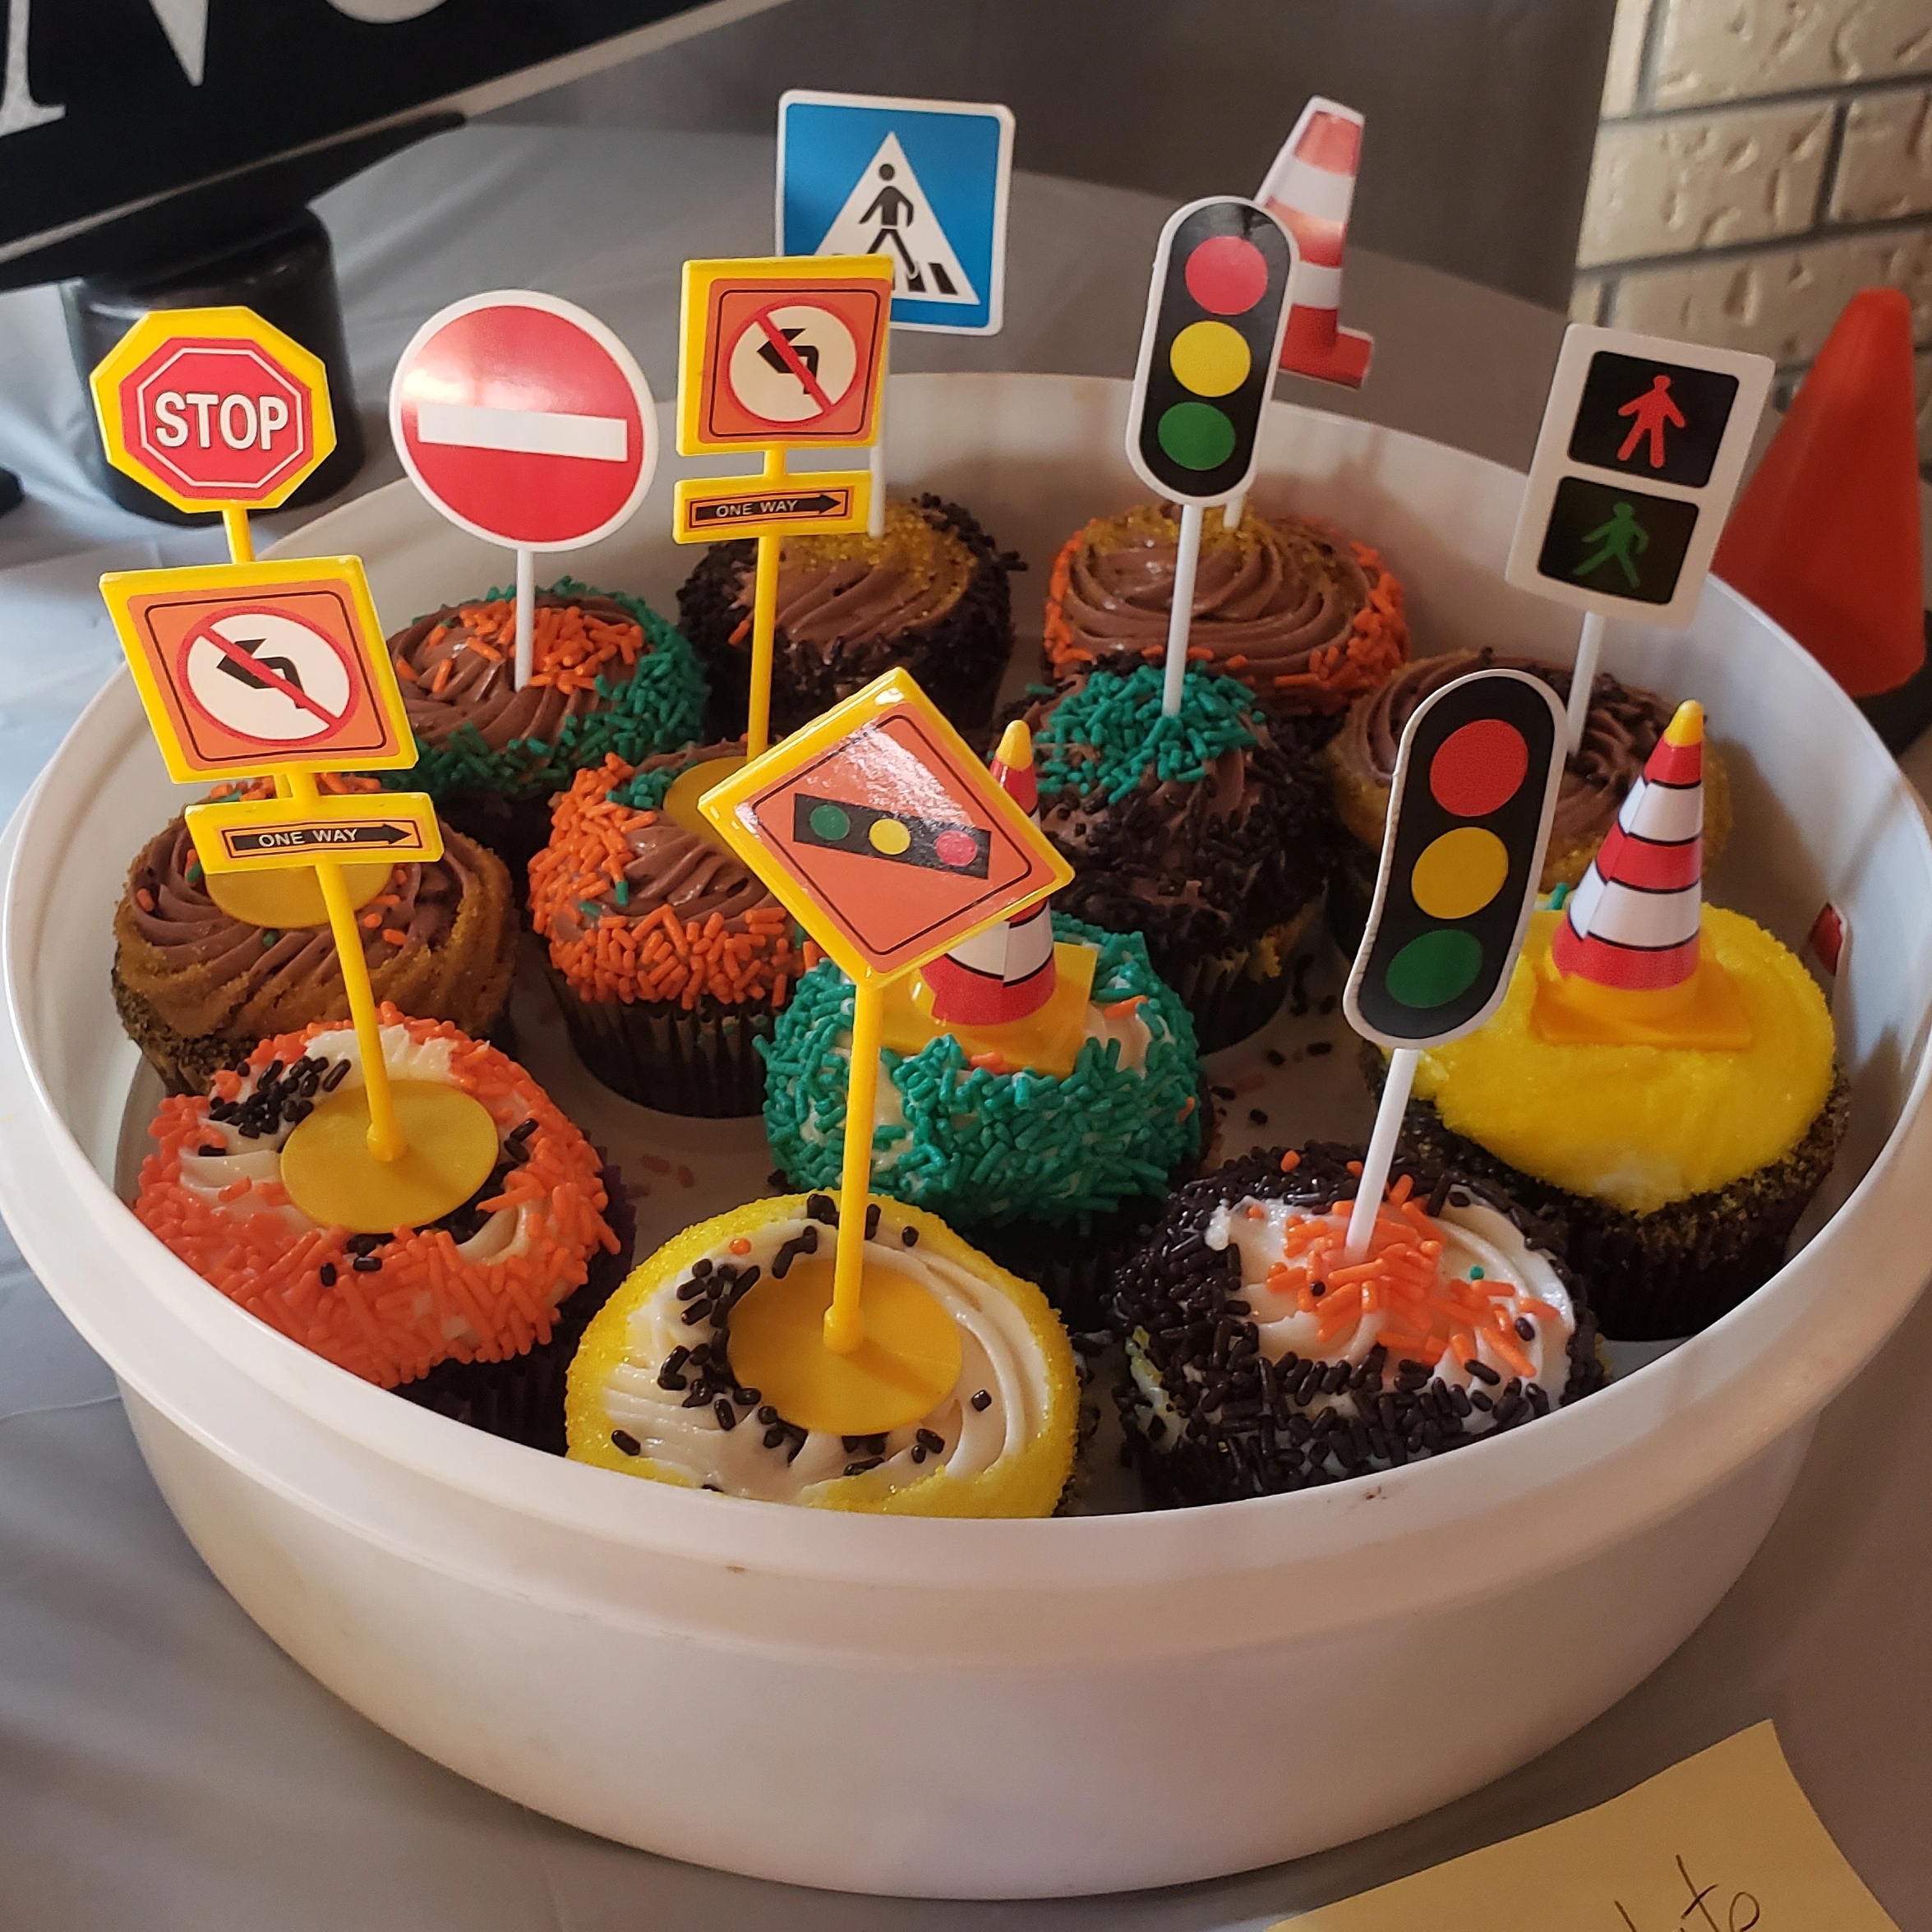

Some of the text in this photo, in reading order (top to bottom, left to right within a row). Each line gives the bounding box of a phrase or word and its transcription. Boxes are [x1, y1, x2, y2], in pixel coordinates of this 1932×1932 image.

[154, 390, 288, 450] STOP
[715, 500, 799, 518] ONE WAY
[258, 828, 358, 847] ONE WAY
